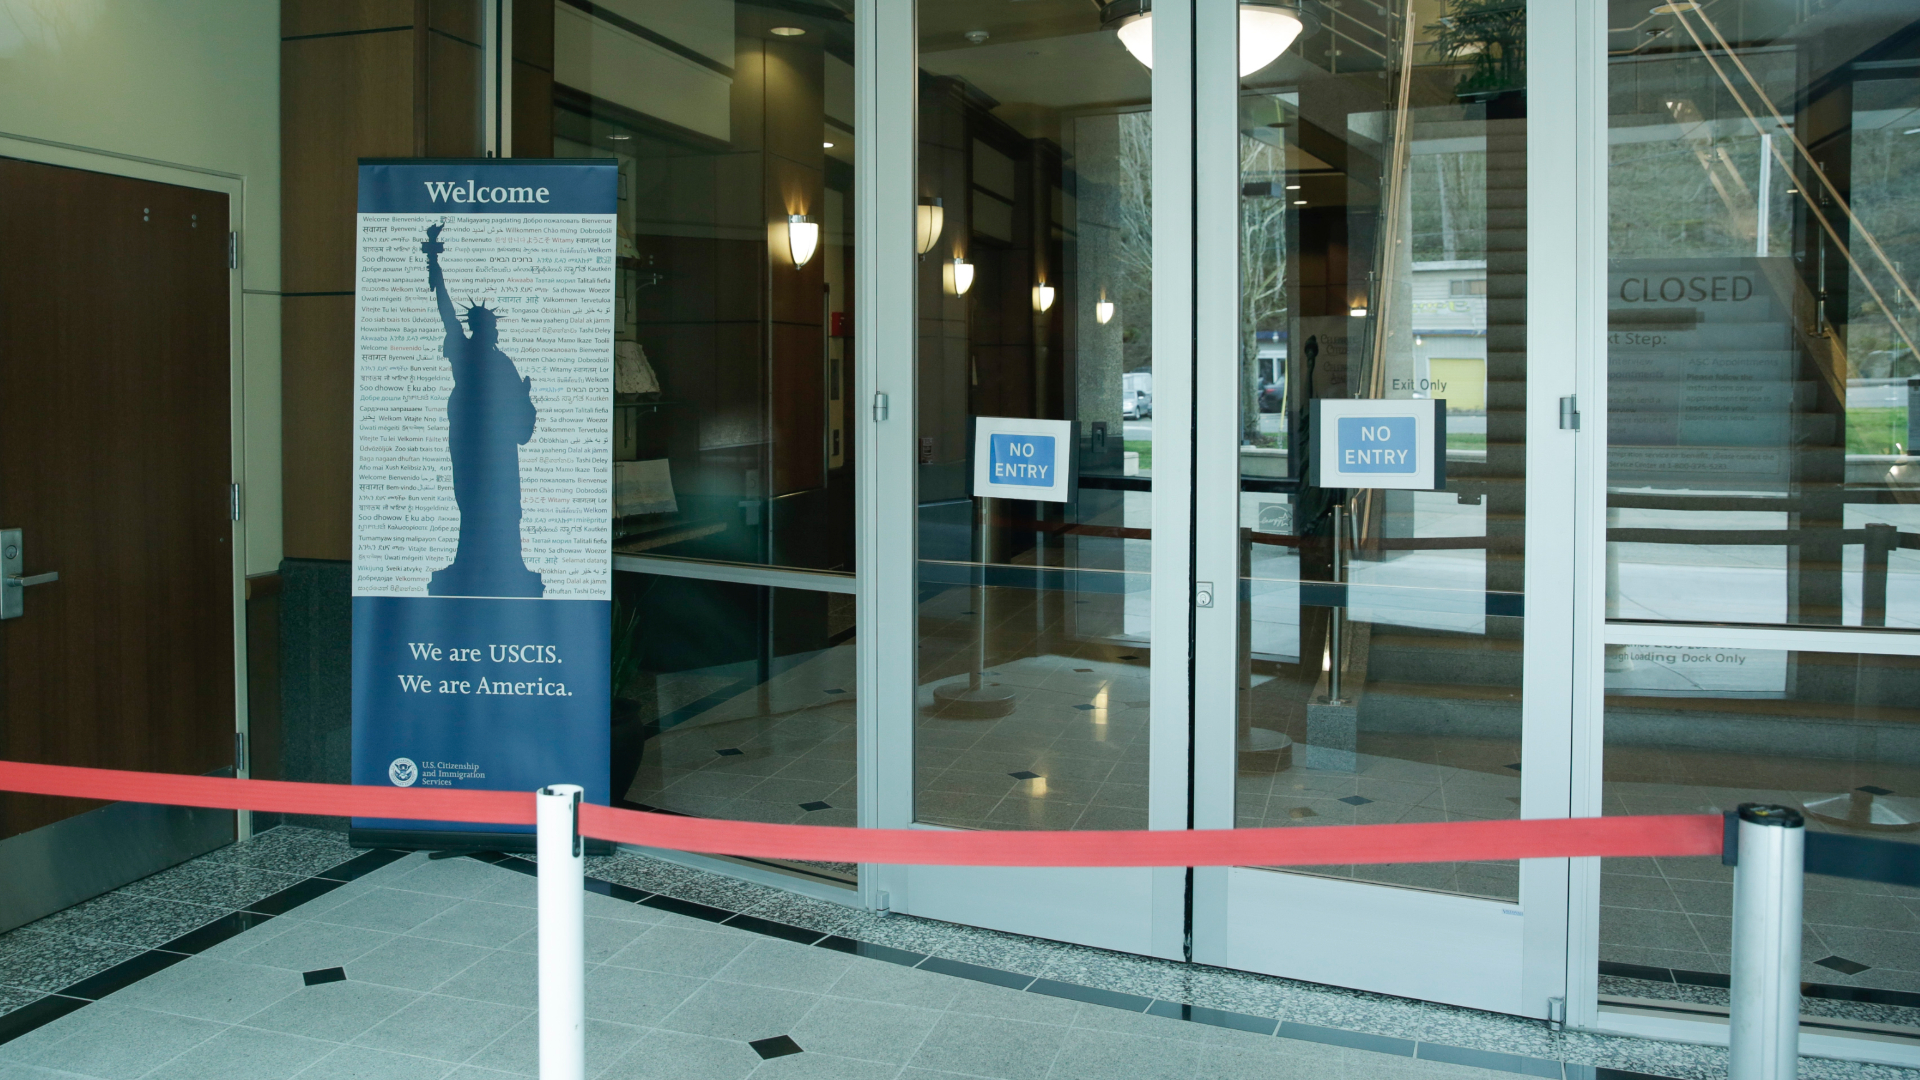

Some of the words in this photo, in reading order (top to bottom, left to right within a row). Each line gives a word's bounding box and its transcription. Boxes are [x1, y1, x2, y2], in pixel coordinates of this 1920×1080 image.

[424, 180, 549, 203] Welcome
[1620, 276, 1752, 302] CLOSED
[1625, 333, 1667, 347] Step:
[1712, 358, 1778, 368] Appointments
[1392, 379, 1415, 391] Exit
[1420, 378, 1447, 393] Only
[1361, 425, 1391, 441] NO
[1010, 443, 1035, 457] NO
[1345, 448, 1409, 465] ENTRY
[995, 462, 1049, 480] ENTRY
[587, 557, 607, 565] datang
[590, 588, 606, 596] Deley
[408, 642, 442, 662] We
[449, 648, 481, 662] are
[489, 644, 562, 664] USCIS.
[1630, 652, 1676, 664] Loading
[1682, 653, 1711, 663] Dock
[1715, 653, 1746, 665] Only
[398, 675, 431, 694] We
[438, 680, 470, 695] are
[476, 676, 573, 697] America.
[422, 761, 436, 769] U.S.
[437, 761, 479, 772] Citizenship
[422, 778, 452, 786] Services
[438, 770, 485, 780] Immigration
